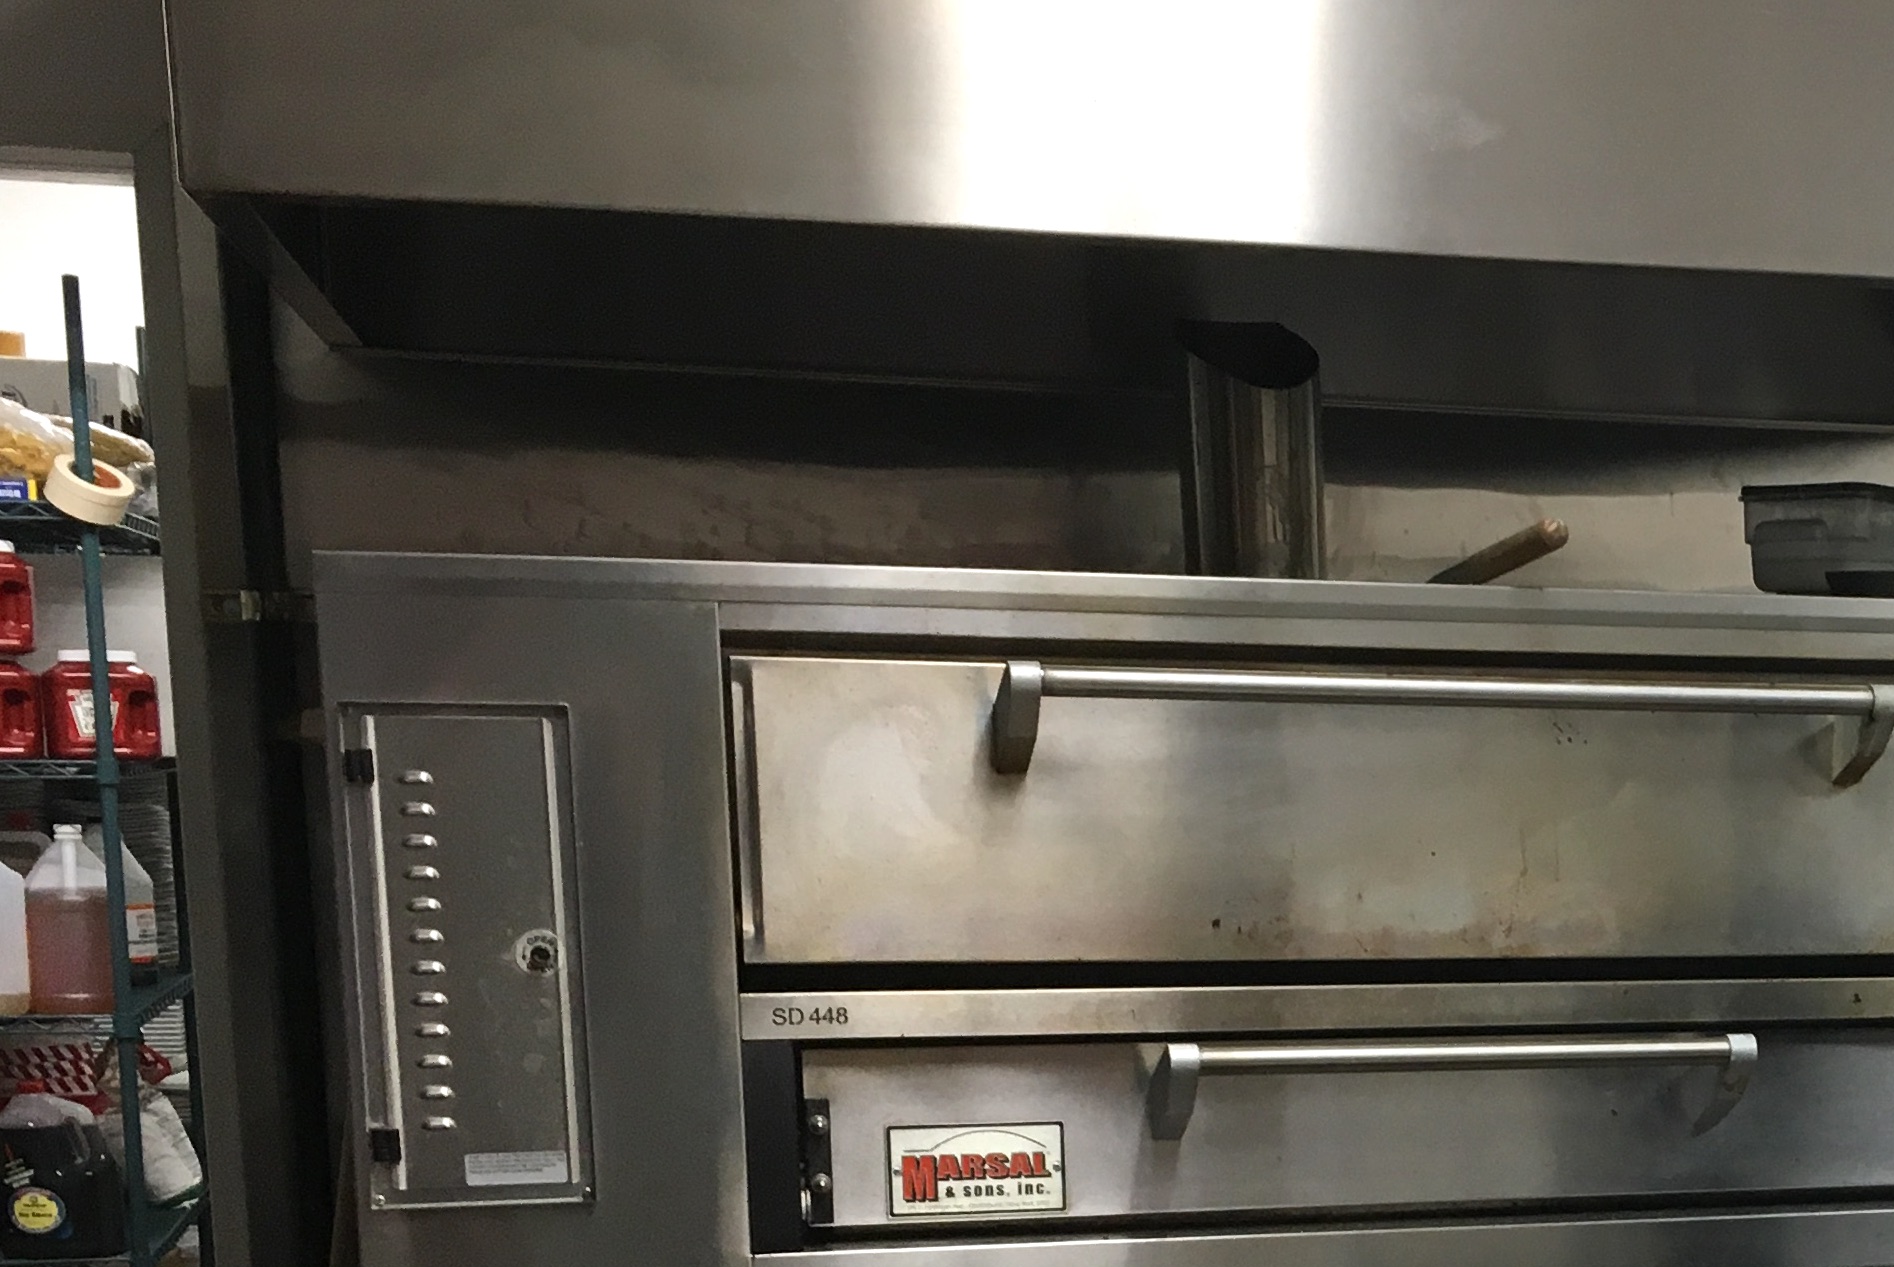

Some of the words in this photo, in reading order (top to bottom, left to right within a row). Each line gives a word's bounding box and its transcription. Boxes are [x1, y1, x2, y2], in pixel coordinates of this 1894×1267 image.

[772, 1007, 804, 1026] SD
[809, 1006, 848, 1025] 448
[901, 1151, 1052, 1203] MARSAL
[945, 1185, 955, 1198] &
